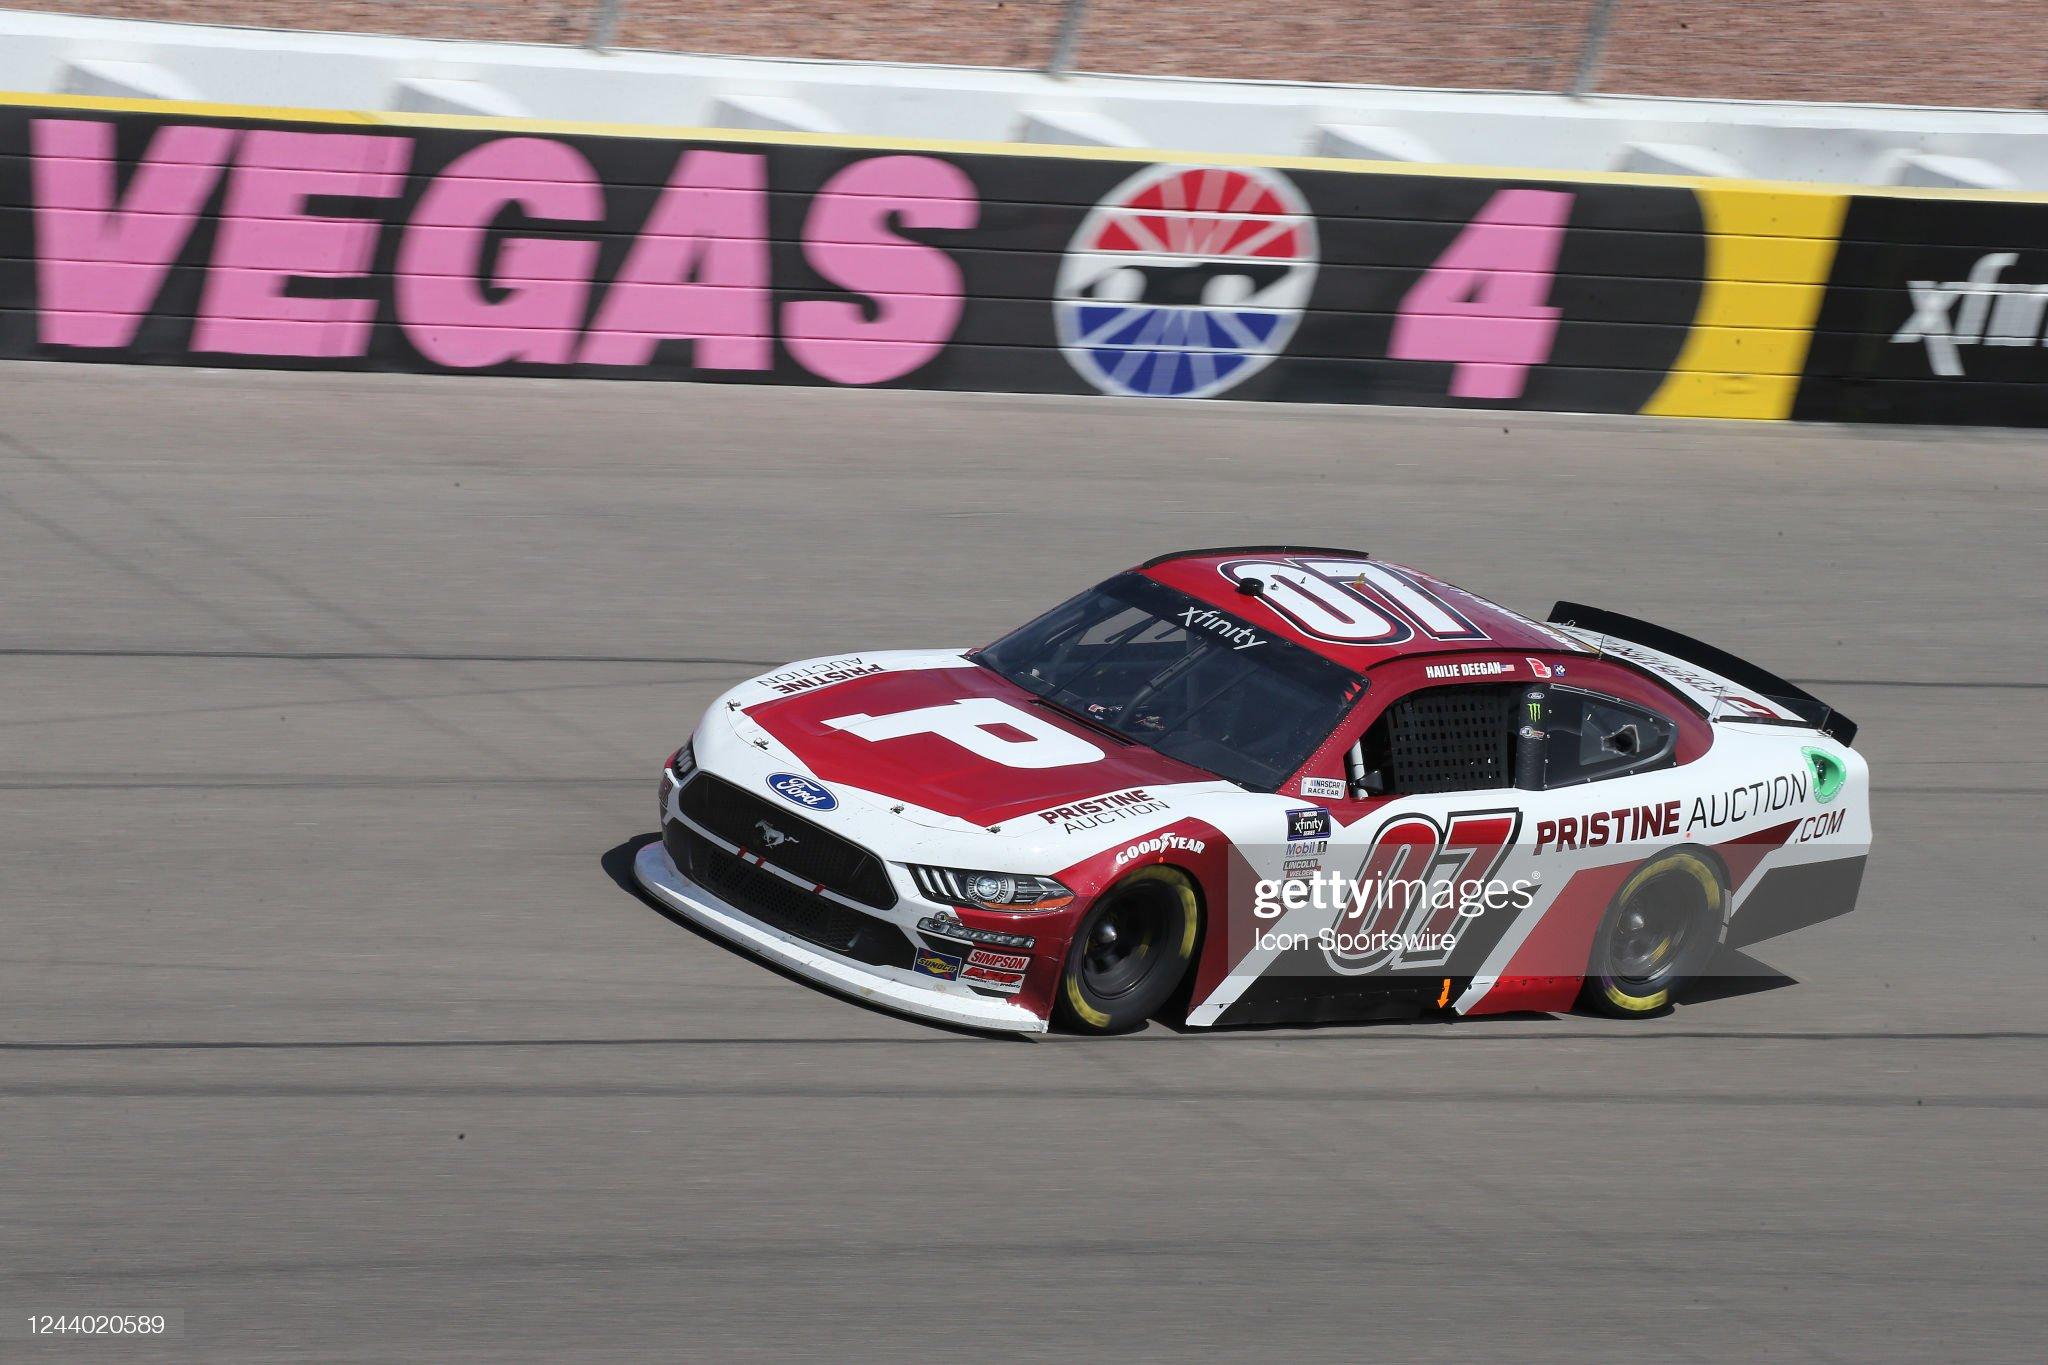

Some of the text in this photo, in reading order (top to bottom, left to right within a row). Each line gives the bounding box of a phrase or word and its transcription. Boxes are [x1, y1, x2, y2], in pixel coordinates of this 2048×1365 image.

[30, 118, 979, 384] VEGAS
[1391, 189, 1573, 398] 4
[1217, 558, 1492, 647] 07
[1178, 606, 1267, 650] xfinity
[757, 657, 863, 686] AUCTION
[772, 663, 887, 694] PRISTINE
[1426, 661, 1502, 678] HAILIE DEEGAN
[820, 697, 1106, 768] P
[775, 777, 824, 805] Ford
[1308, 787, 1325, 795] RACE
[1316, 780, 1341, 788] NASCAR
[1037, 790, 1154, 825] PRISTINE
[1064, 801, 1170, 834] AUCTION
[1533, 772, 1808, 856] PRISTINE AUCTION
[1295, 818, 1323, 833] xfinity
[1795, 809, 1846, 845] .COM
[1115, 832, 1205, 865] GOODYEAR
[1286, 842, 1315, 855] Mobil
[1284, 859, 1317, 870] LINCOLN
[1289, 869, 1320, 877] WELDER
[1323, 807, 1523, 975] 07
[918, 958, 957, 972] SUNOCO
[971, 951, 1024, 969] SIMPSON
